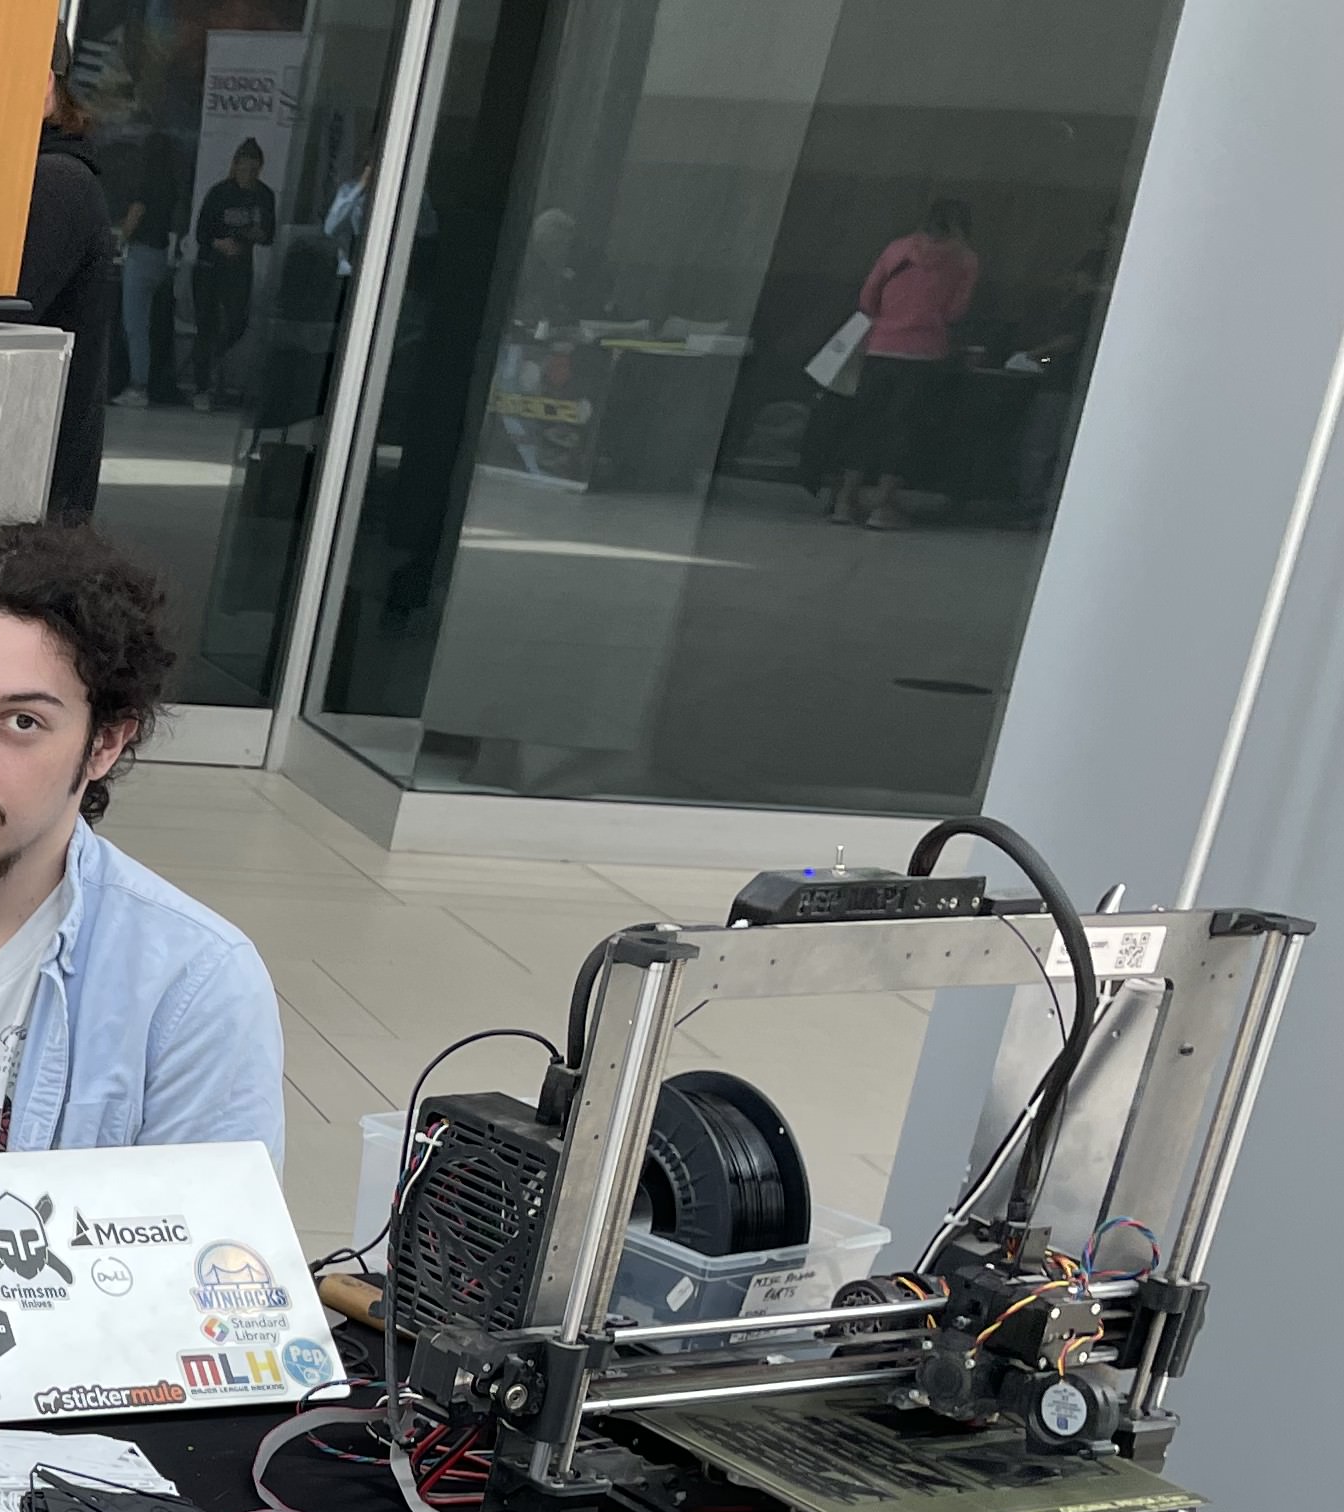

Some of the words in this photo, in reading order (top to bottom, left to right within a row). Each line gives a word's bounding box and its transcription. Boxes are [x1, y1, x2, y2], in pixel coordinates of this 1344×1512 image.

[93, 1218, 188, 1246] Mosaic
[97, 1270, 129, 1282] DELL
[0, 1284, 67, 1300] Grimsmo
[197, 1287, 290, 1309] WINHACKS
[21, 1300, 53, 1309] Knives
[231, 1317, 287, 1329] Standard
[235, 1330, 278, 1343] Library
[288, 1345, 325, 1367] Pep
[181, 1350, 282, 1387] MLH
[62, 1382, 184, 1410] stickermule
